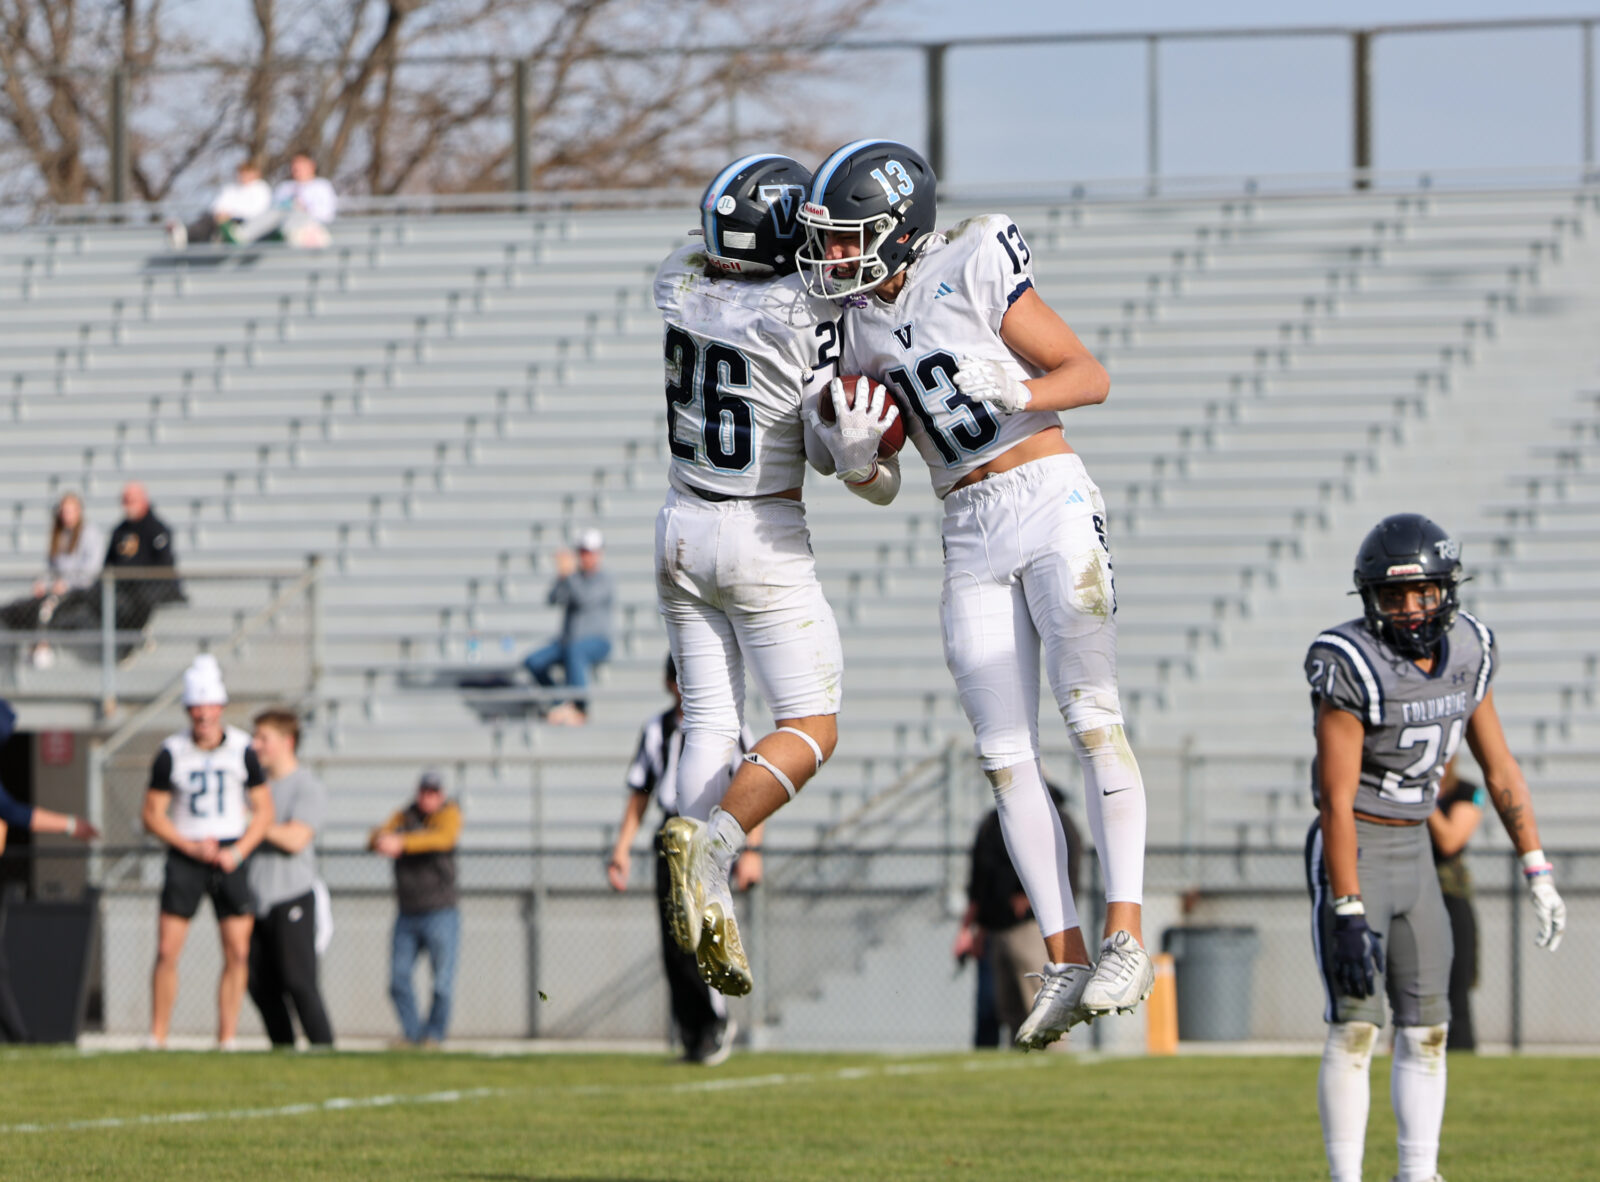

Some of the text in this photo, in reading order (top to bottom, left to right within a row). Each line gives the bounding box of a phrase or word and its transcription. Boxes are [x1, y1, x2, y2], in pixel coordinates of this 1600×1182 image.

[870, 160, 915, 206] 13
[759, 185, 806, 239] V
[805, 203, 824, 216] Riddell
[997, 223, 1030, 275] 13
[891, 321, 915, 352] V
[664, 326, 755, 474] 26
[887, 348, 1001, 468] 13
[1379, 716, 1464, 805] 21
[190, 770, 228, 818] 21
